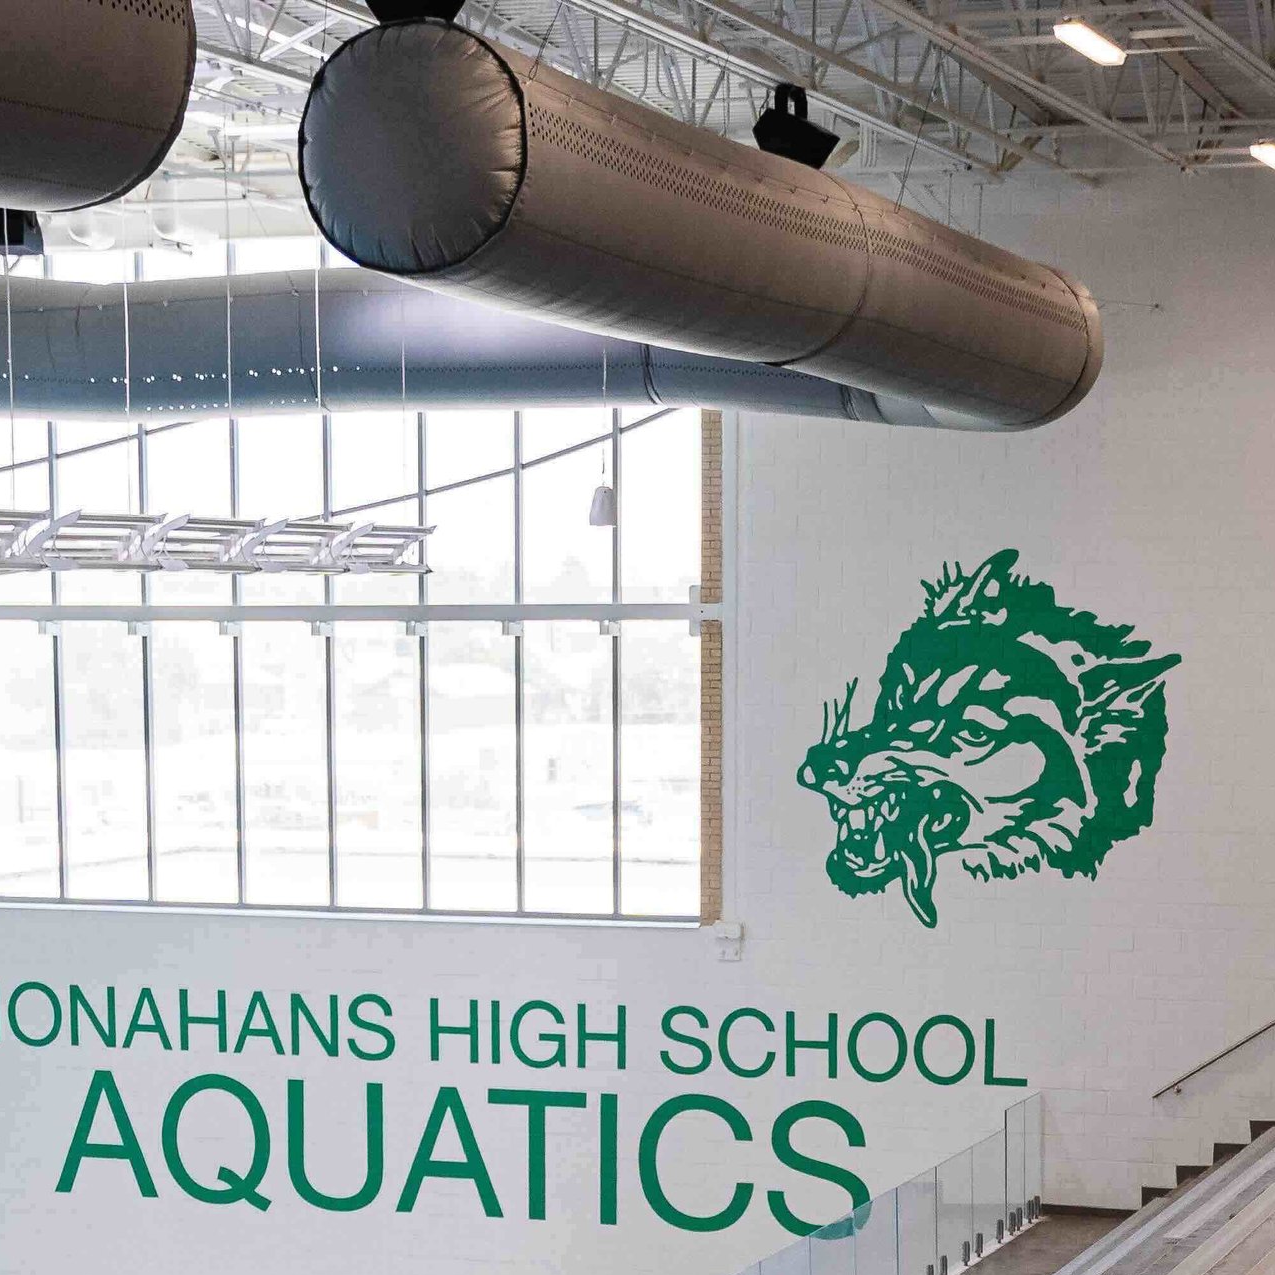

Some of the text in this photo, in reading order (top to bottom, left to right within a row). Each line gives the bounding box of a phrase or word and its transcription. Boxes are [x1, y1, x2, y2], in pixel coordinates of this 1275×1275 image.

[429, 997, 627, 1070] HIGH
[661, 1006, 1028, 1087] SCHOOL
[55, 1068, 873, 1240] AQUATICS
